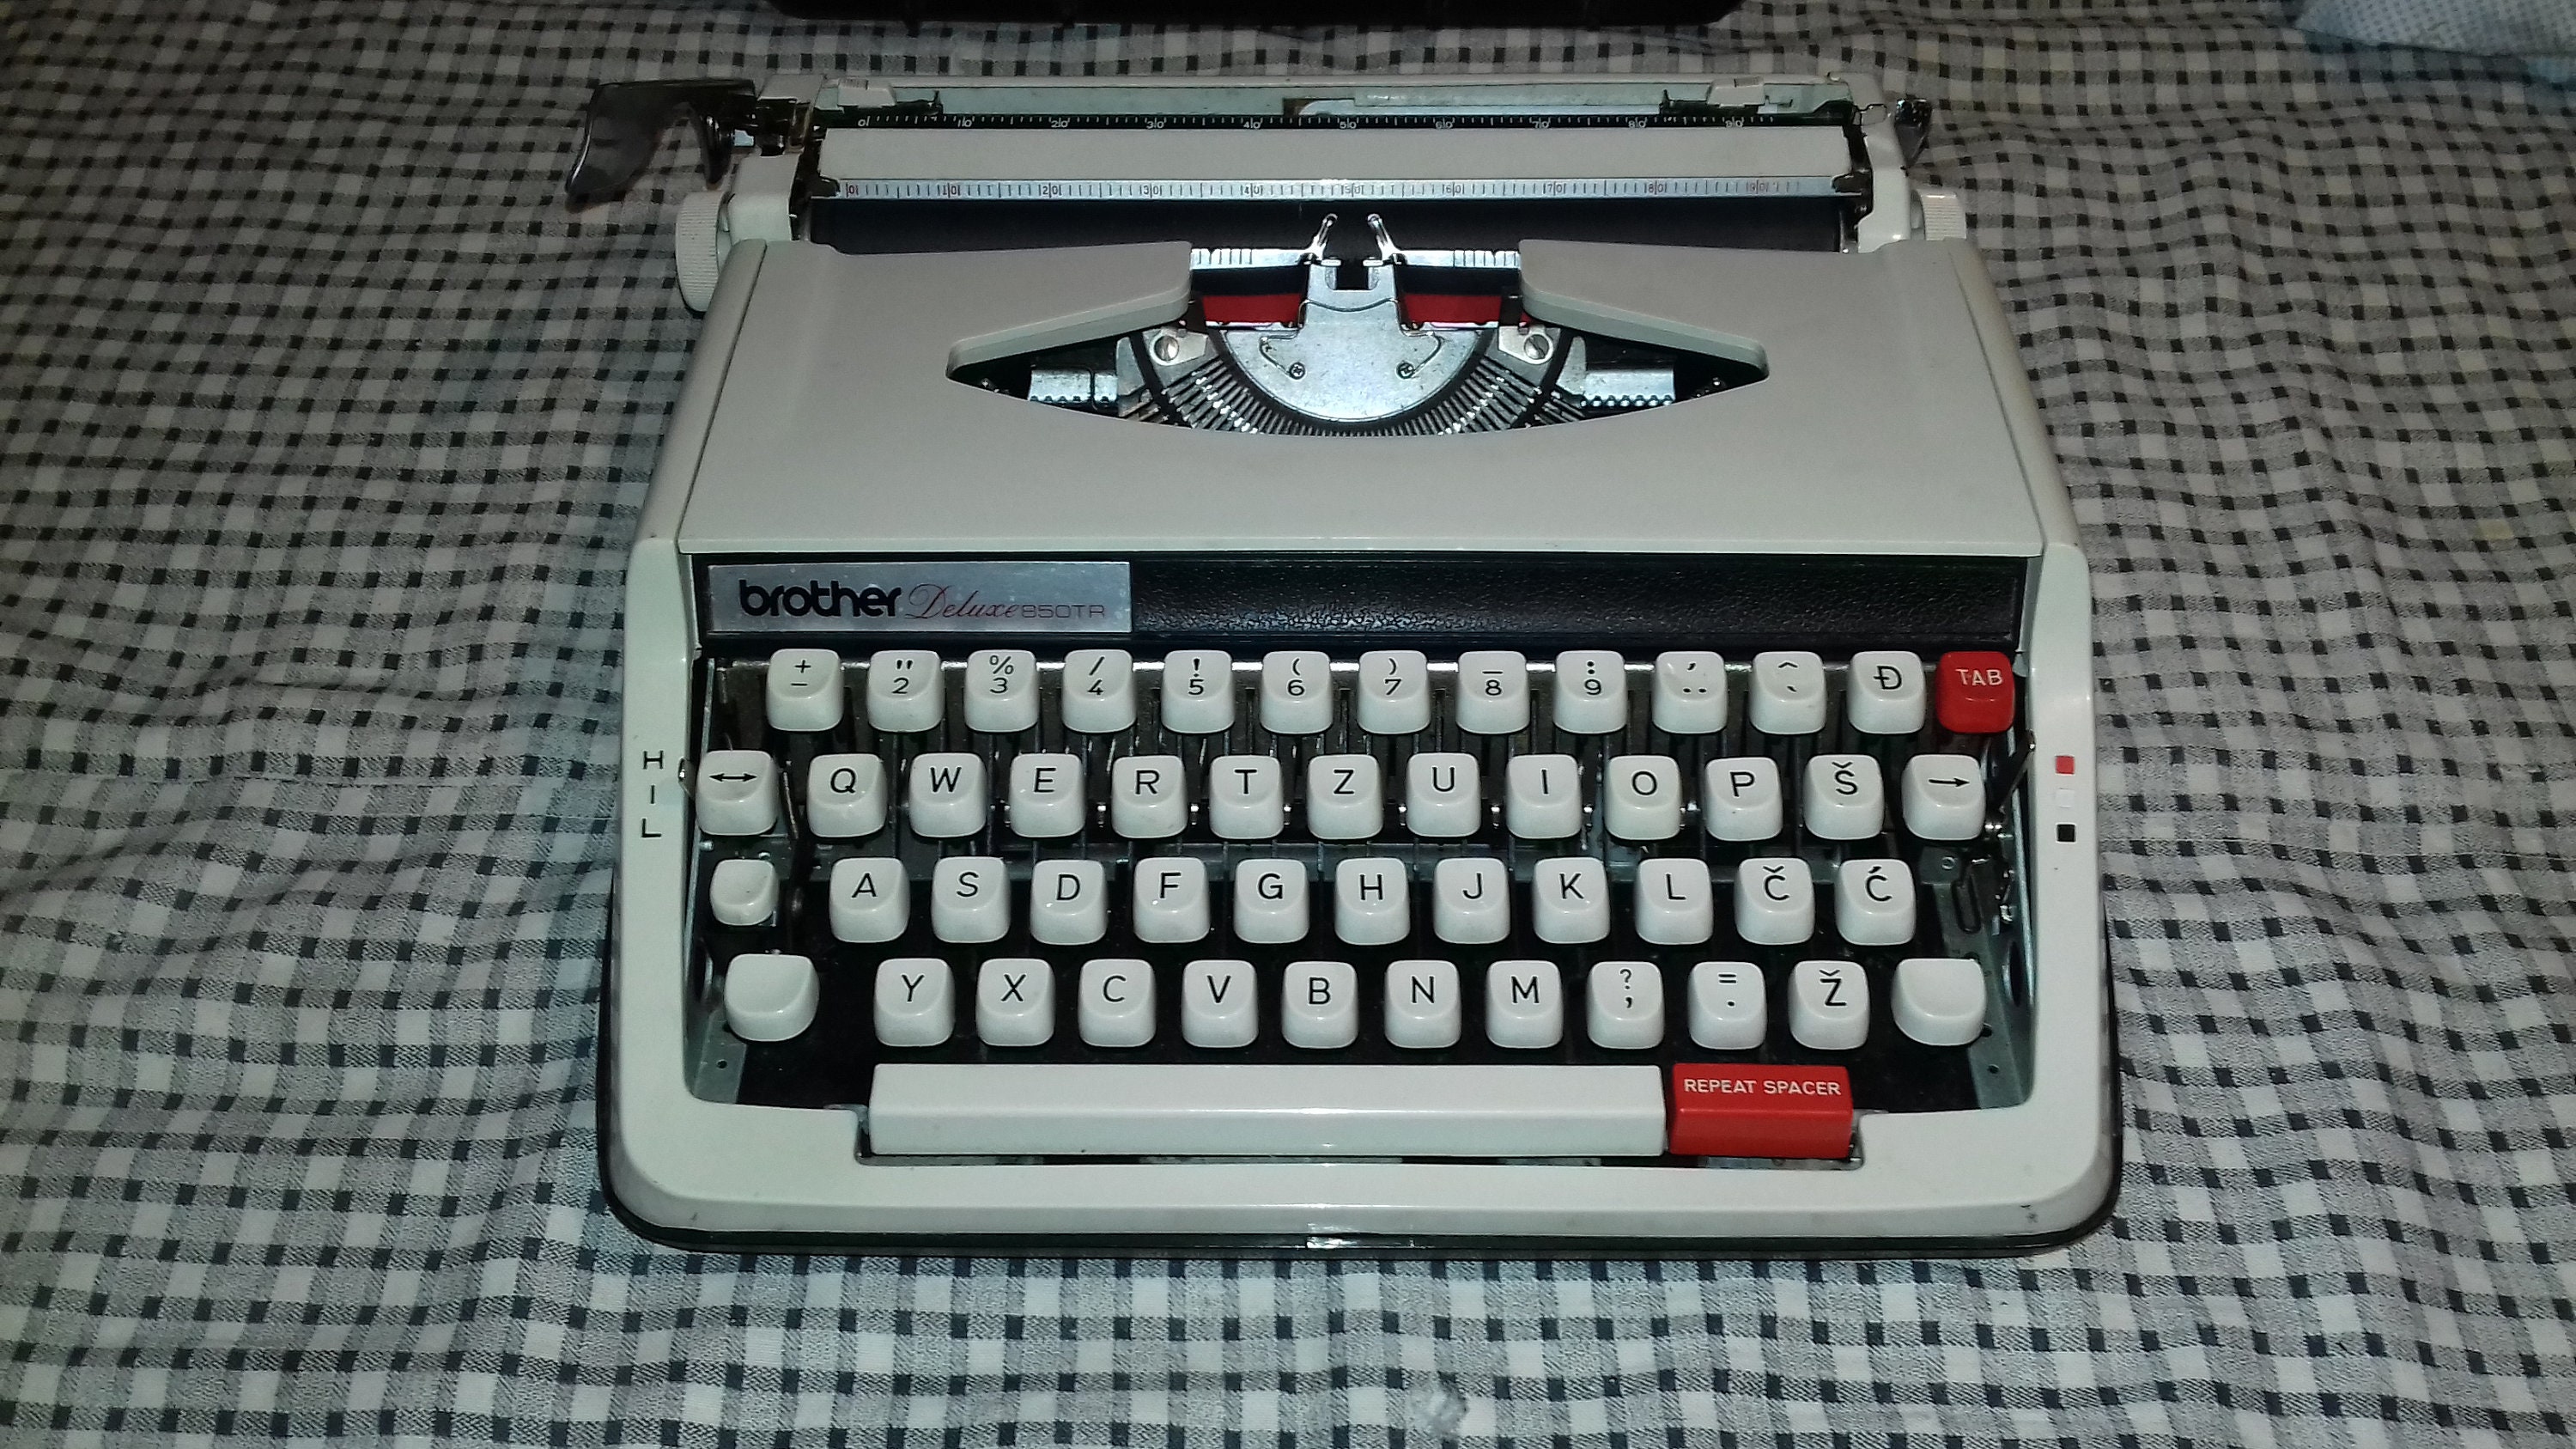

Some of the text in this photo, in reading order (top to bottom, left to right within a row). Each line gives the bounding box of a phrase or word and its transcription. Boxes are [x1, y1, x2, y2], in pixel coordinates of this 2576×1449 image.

[1051, 119, 1068, 128] 20
[1146, 120, 1164, 129] 30
[1042, 185, 1058, 195] 20
[1143, 185, 1159, 195] 30
[1243, 185, 1259, 195] 40
[1547, 185, 1564, 194] 70
[738, 580, 902, 617] brother
[903, 583, 1021, 620] Deluxe
[891, 677, 909, 695] 2
[989, 677, 1008, 694] 3
[1087, 679, 1104, 696] 4
[1188, 679, 1204, 696] 5
[1287, 679, 1305, 697] 6
[1384, 679, 1402, 696] 7
[1485, 679, 1503, 697] 8
[1584, 679, 1602, 696] 9
[1956, 668, 2005, 687] TAB
[642, 750, 664, 770] H
[829, 768, 856, 794] Q
[930, 766, 962, 793] W
[1033, 767, 1057, 793] E
[1135, 770, 1160, 795] R
[1234, 769, 1258, 795] T
[1333, 769, 1355, 795] Z
[1431, 766, 1455, 793] U
[1541, 769, 1549, 795] I
[1729, 771, 1755, 797] P
[1832, 761, 1858, 795] Š
[641, 818, 662, 838] L
[851, 865, 1893, 902] A S D F G H J K L Č Ć
[902, 974, 925, 1002] Y
[1000, 974, 1026, 1002] X
[1103, 975, 1127, 1002] C
[1206, 975, 1231, 1004] V
[1309, 977, 1331, 1005] B
[1411, 976, 1435, 1004] N
[1510, 976, 1540, 1004] M
[1819, 969, 1847, 1007] Ž
[1684, 1078, 1842, 1097] REPEAT SPACER
